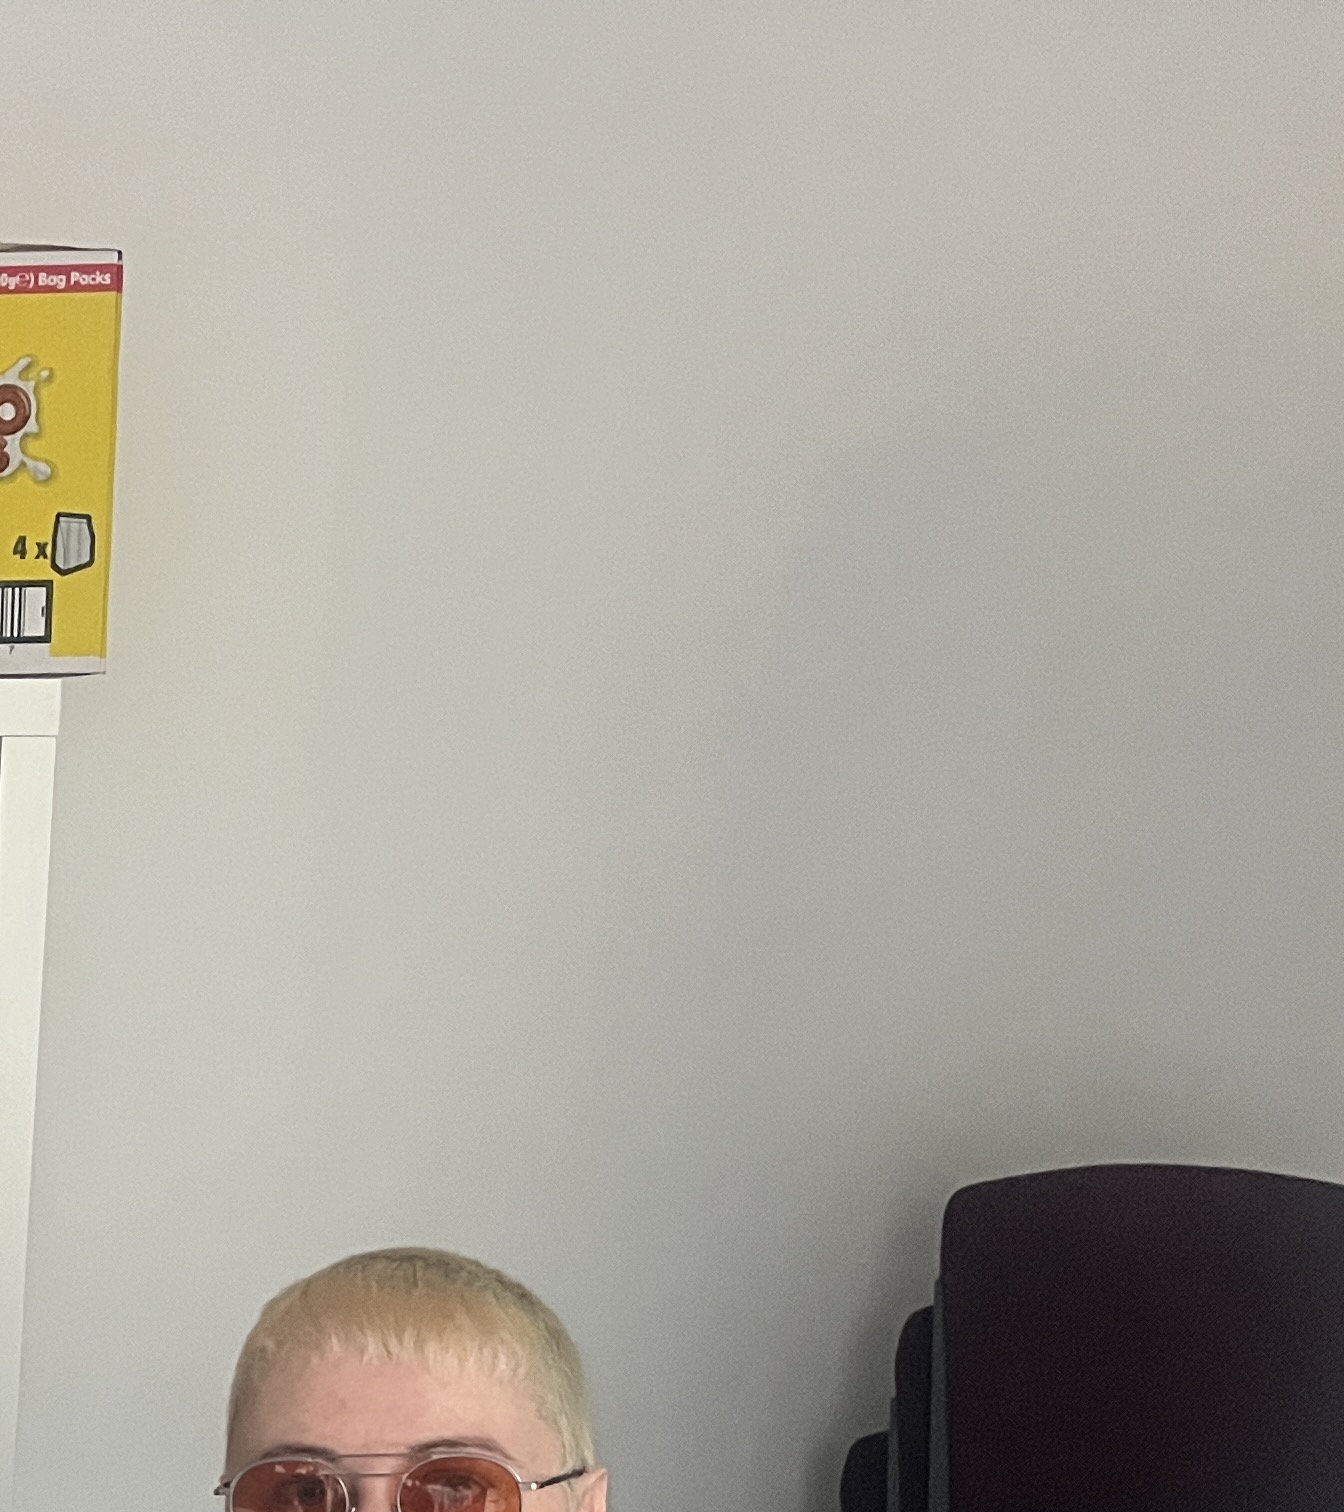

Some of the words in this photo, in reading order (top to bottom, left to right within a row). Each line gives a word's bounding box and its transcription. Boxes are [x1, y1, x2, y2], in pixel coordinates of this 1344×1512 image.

[38, 273, 66, 289] Bag
[70, 271, 111, 287] Packs
[12, 535, 28, 560] 4
[34, 542, 49, 560] x
